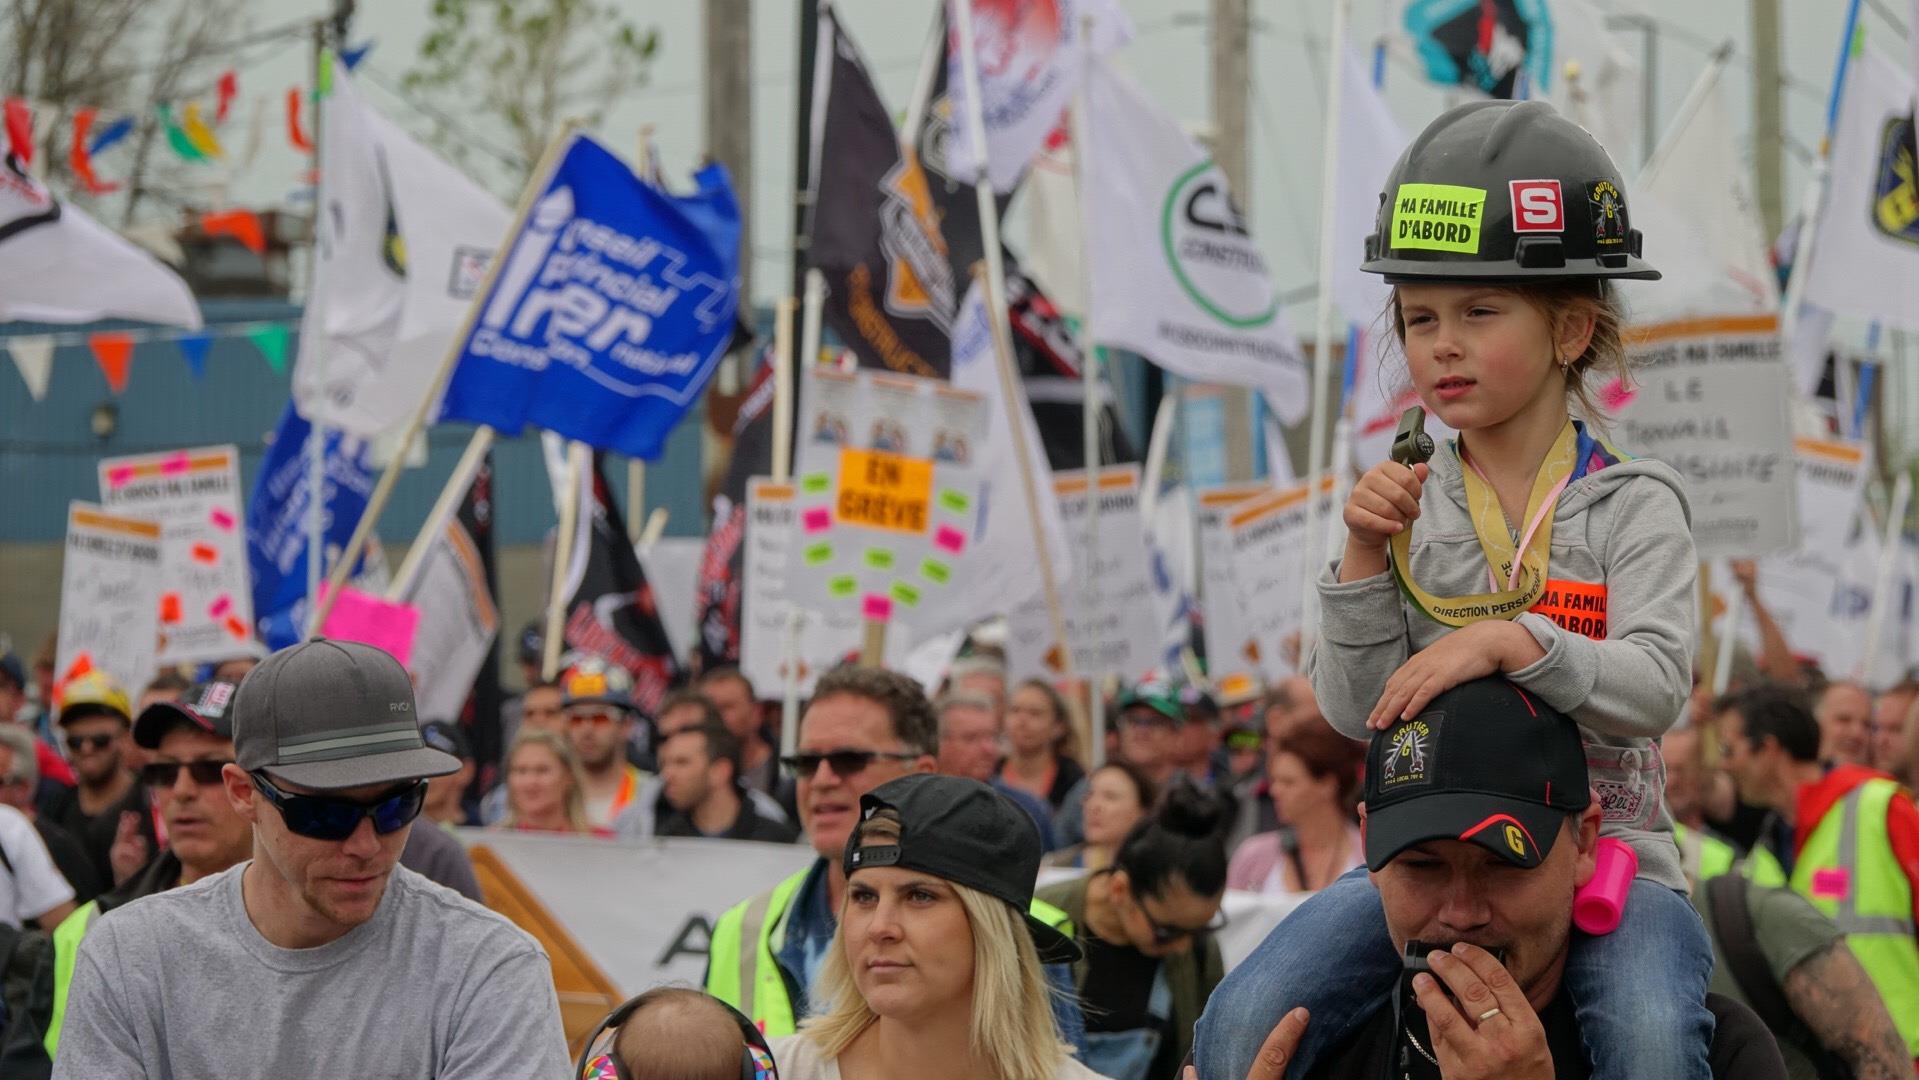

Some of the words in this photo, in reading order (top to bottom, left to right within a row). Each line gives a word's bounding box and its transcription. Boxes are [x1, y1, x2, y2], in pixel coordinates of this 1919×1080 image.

[1400, 198, 1417, 214] MA
[1419, 198, 1478, 219] FAMILLE
[1520, 187, 1558, 224] S
[1606, 203, 1614, 219] G
[1399, 219, 1472, 244] D'ABORD
[865, 454, 901, 487] EN
[1432, 605, 1489, 618] DIRECTION
[1536, 590, 1559, 608] MA
[1563, 592, 1607, 613] FAMIL
[1538, 612, 1607, 640] 'ABOR
[1392, 720, 1429, 742] GRUTIER
[1401, 740, 1411, 757] G
[1505, 825, 1525, 857] G
